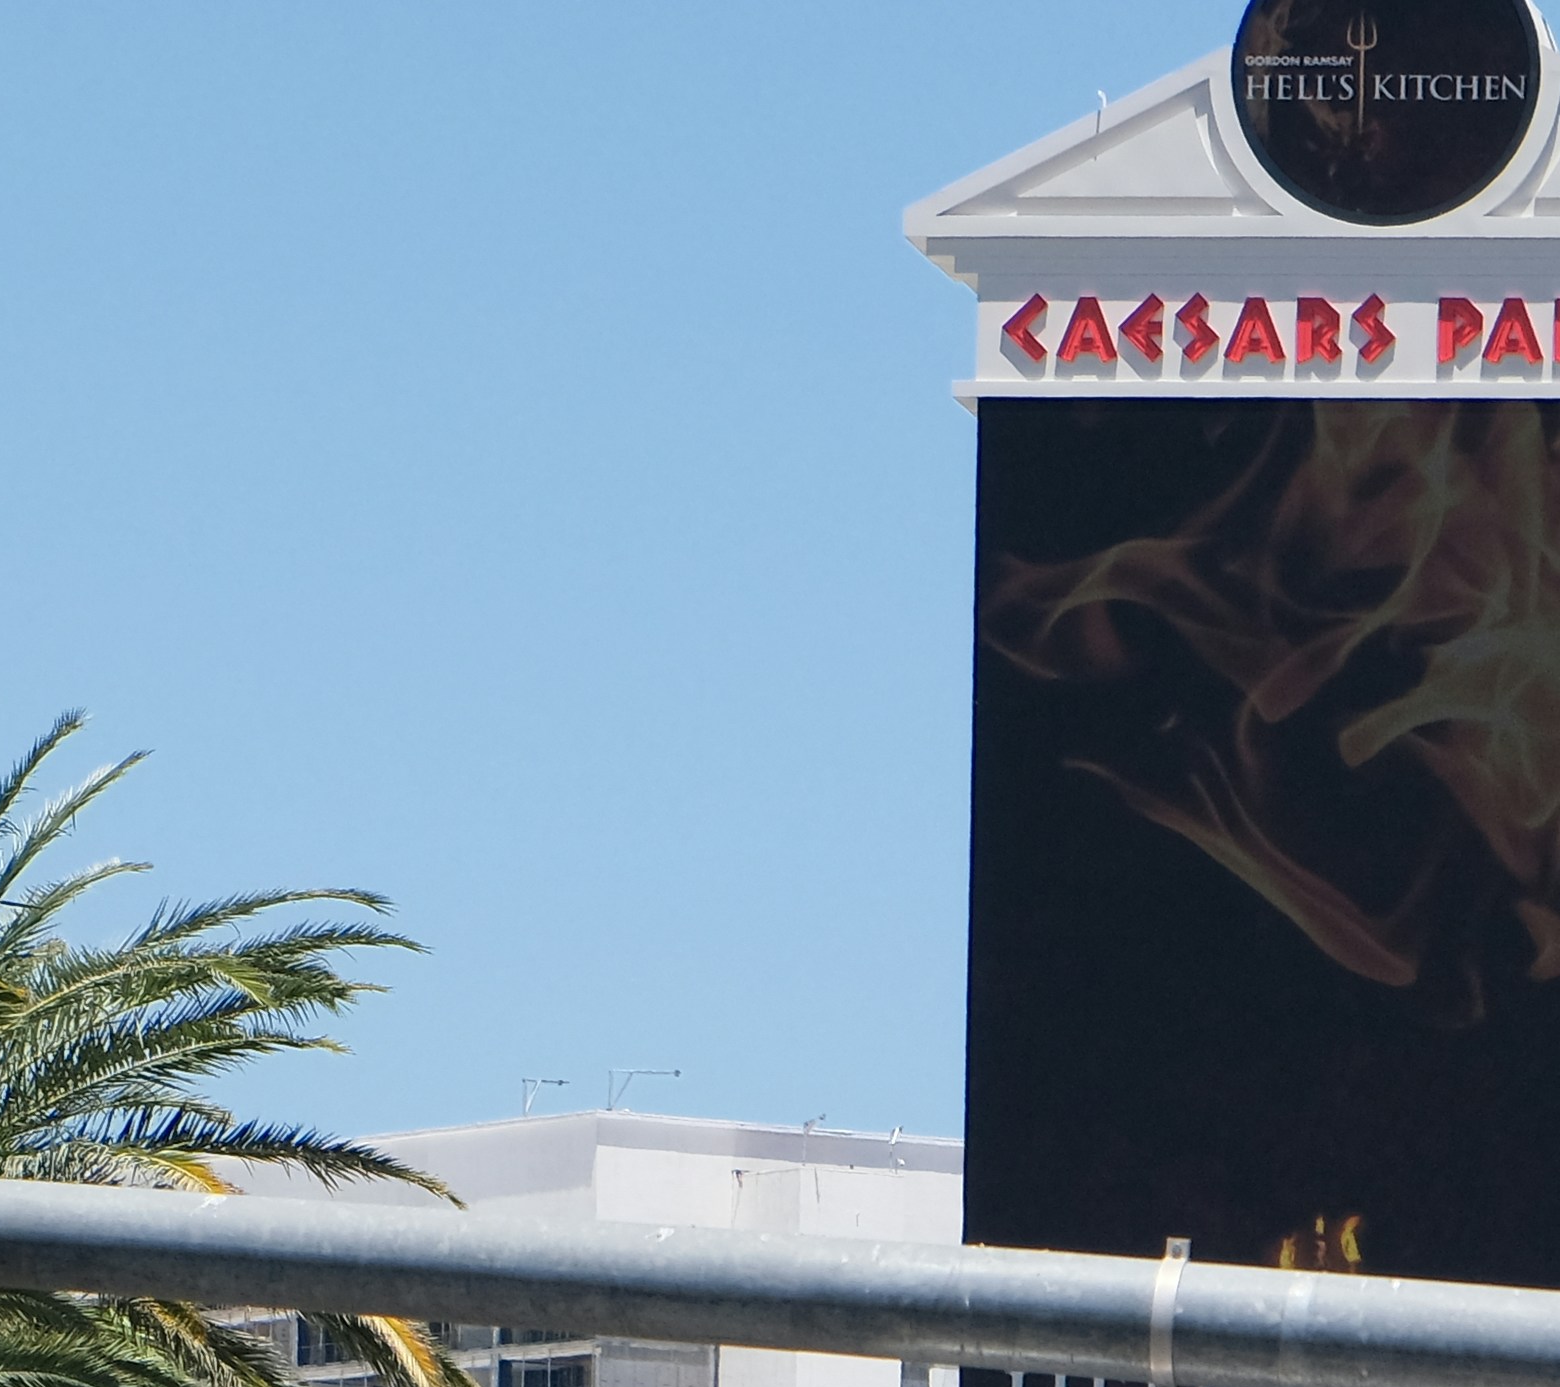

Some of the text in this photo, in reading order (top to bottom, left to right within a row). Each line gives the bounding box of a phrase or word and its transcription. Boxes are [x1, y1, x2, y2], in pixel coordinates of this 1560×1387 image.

[1244, 55, 1354, 67] GORDON RAMSAY
[1246, 73, 1527, 101] HELL'S KITCHEN
[1000, 292, 1396, 366] CAESARS
